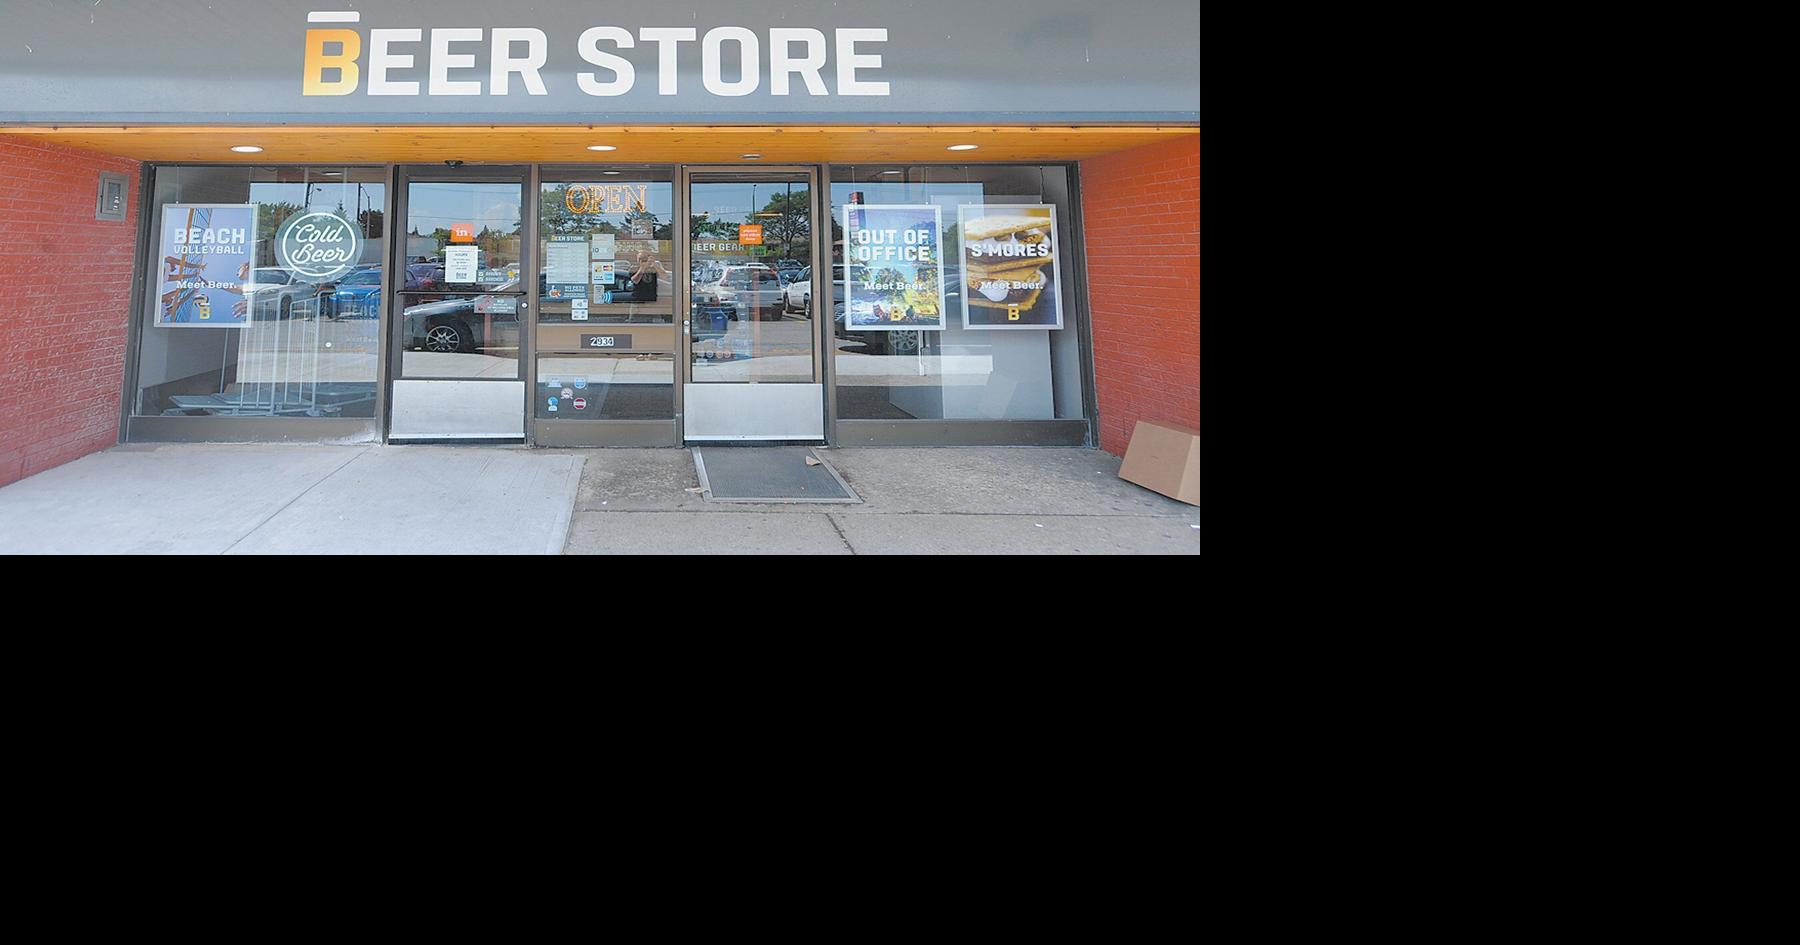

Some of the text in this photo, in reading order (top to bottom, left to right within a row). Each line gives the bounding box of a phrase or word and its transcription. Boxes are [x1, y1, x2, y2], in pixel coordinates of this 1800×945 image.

[302, 11, 891, 97] BEER STORE
[565, 184, 648, 215] OPEN
[173, 227, 245, 244] BEACH
[295, 223, 343, 243] Cold
[858, 229, 929, 246] OUT OF
[173, 245, 244, 255] VOLLEYBALL
[291, 242, 351, 265] Beer
[858, 246, 931, 262] OFFICE
[970, 243, 1049, 257] S'MORES
[175, 280, 237, 289] Meet Beer.
[863, 281, 894, 291] Meet
[981, 281, 1043, 291] Meet Beer.
